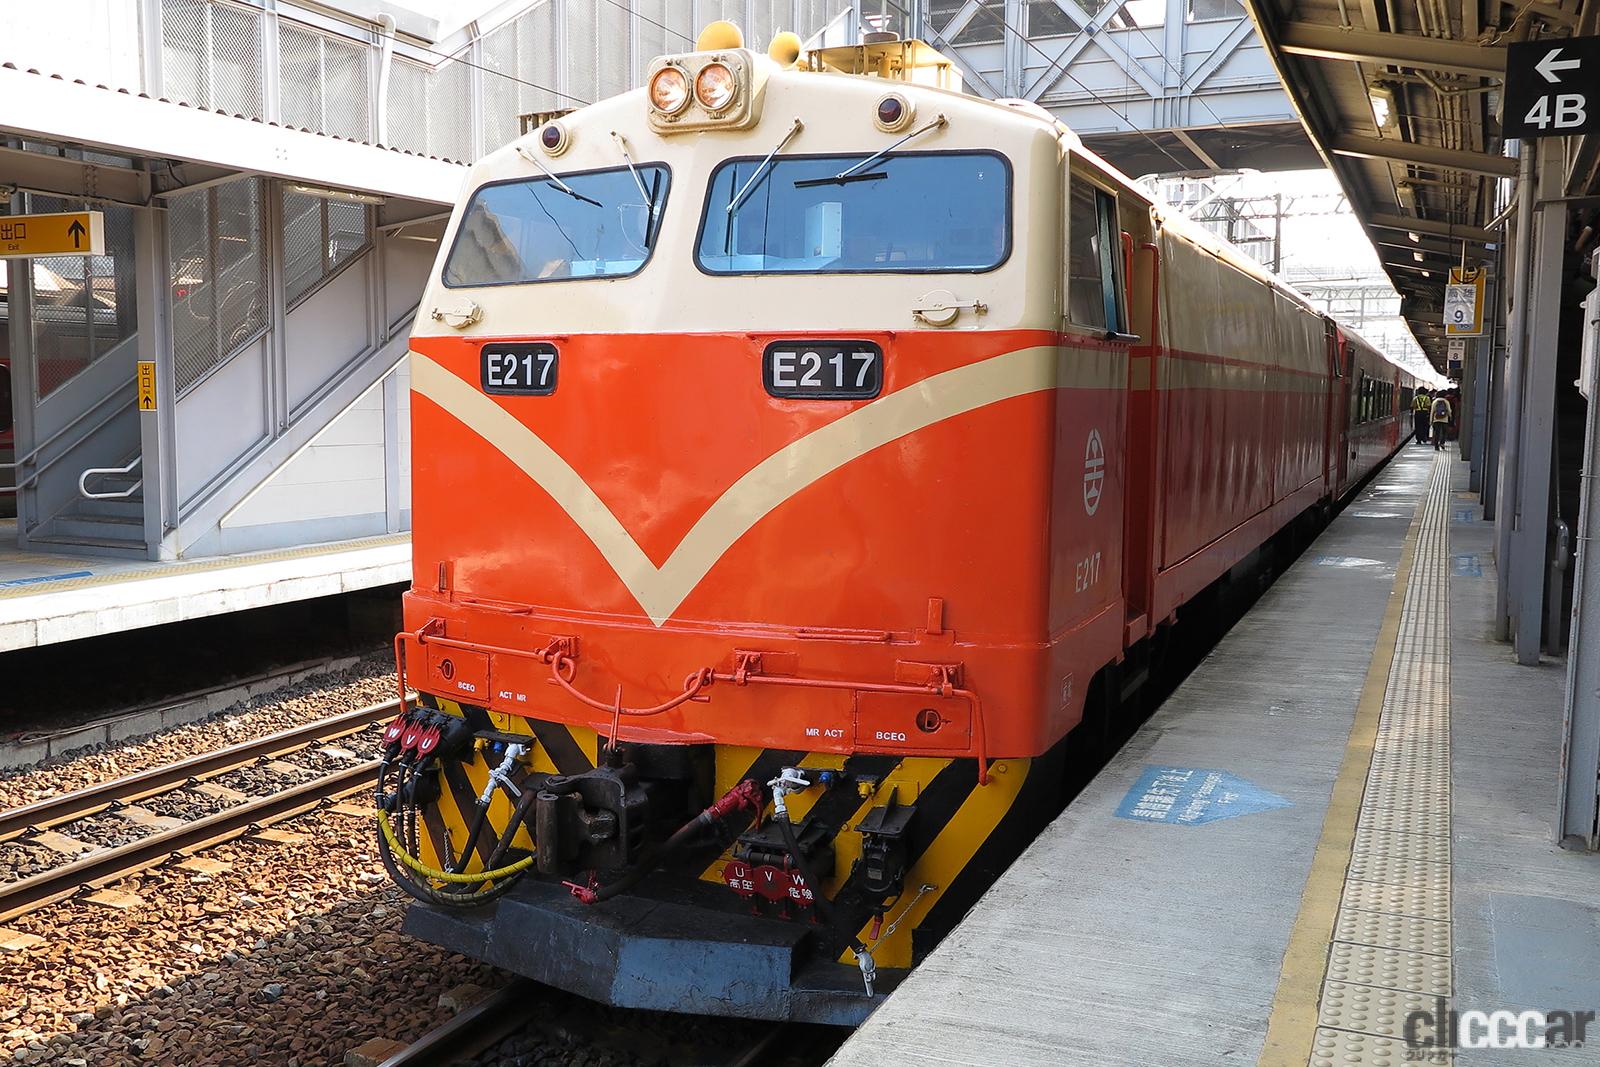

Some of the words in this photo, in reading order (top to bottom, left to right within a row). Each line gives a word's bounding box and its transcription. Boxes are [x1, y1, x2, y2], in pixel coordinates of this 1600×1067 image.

[1524, 93, 1587, 129] 4B
[1, 223, 26, 240] 出口
[1454, 310, 1464, 323] 9
[142, 364, 151, 388] 出口
[487, 353, 555, 386] E217
[773, 351, 876, 387] E217
[1075, 552, 1101, 593] E217
[499, 690, 513, 700] ACT
[516, 693, 527, 702] MR
[387, 727, 398, 738] W
[406, 735, 415, 745] V
[421, 738, 432, 749] U
[806, 728, 820, 737] MR
[824, 728, 844, 738] ACT
[876, 731, 906, 741] BCEQ
[735, 866, 744, 878] U
[764, 870, 773, 881] V
[792, 874, 804, 886] W
